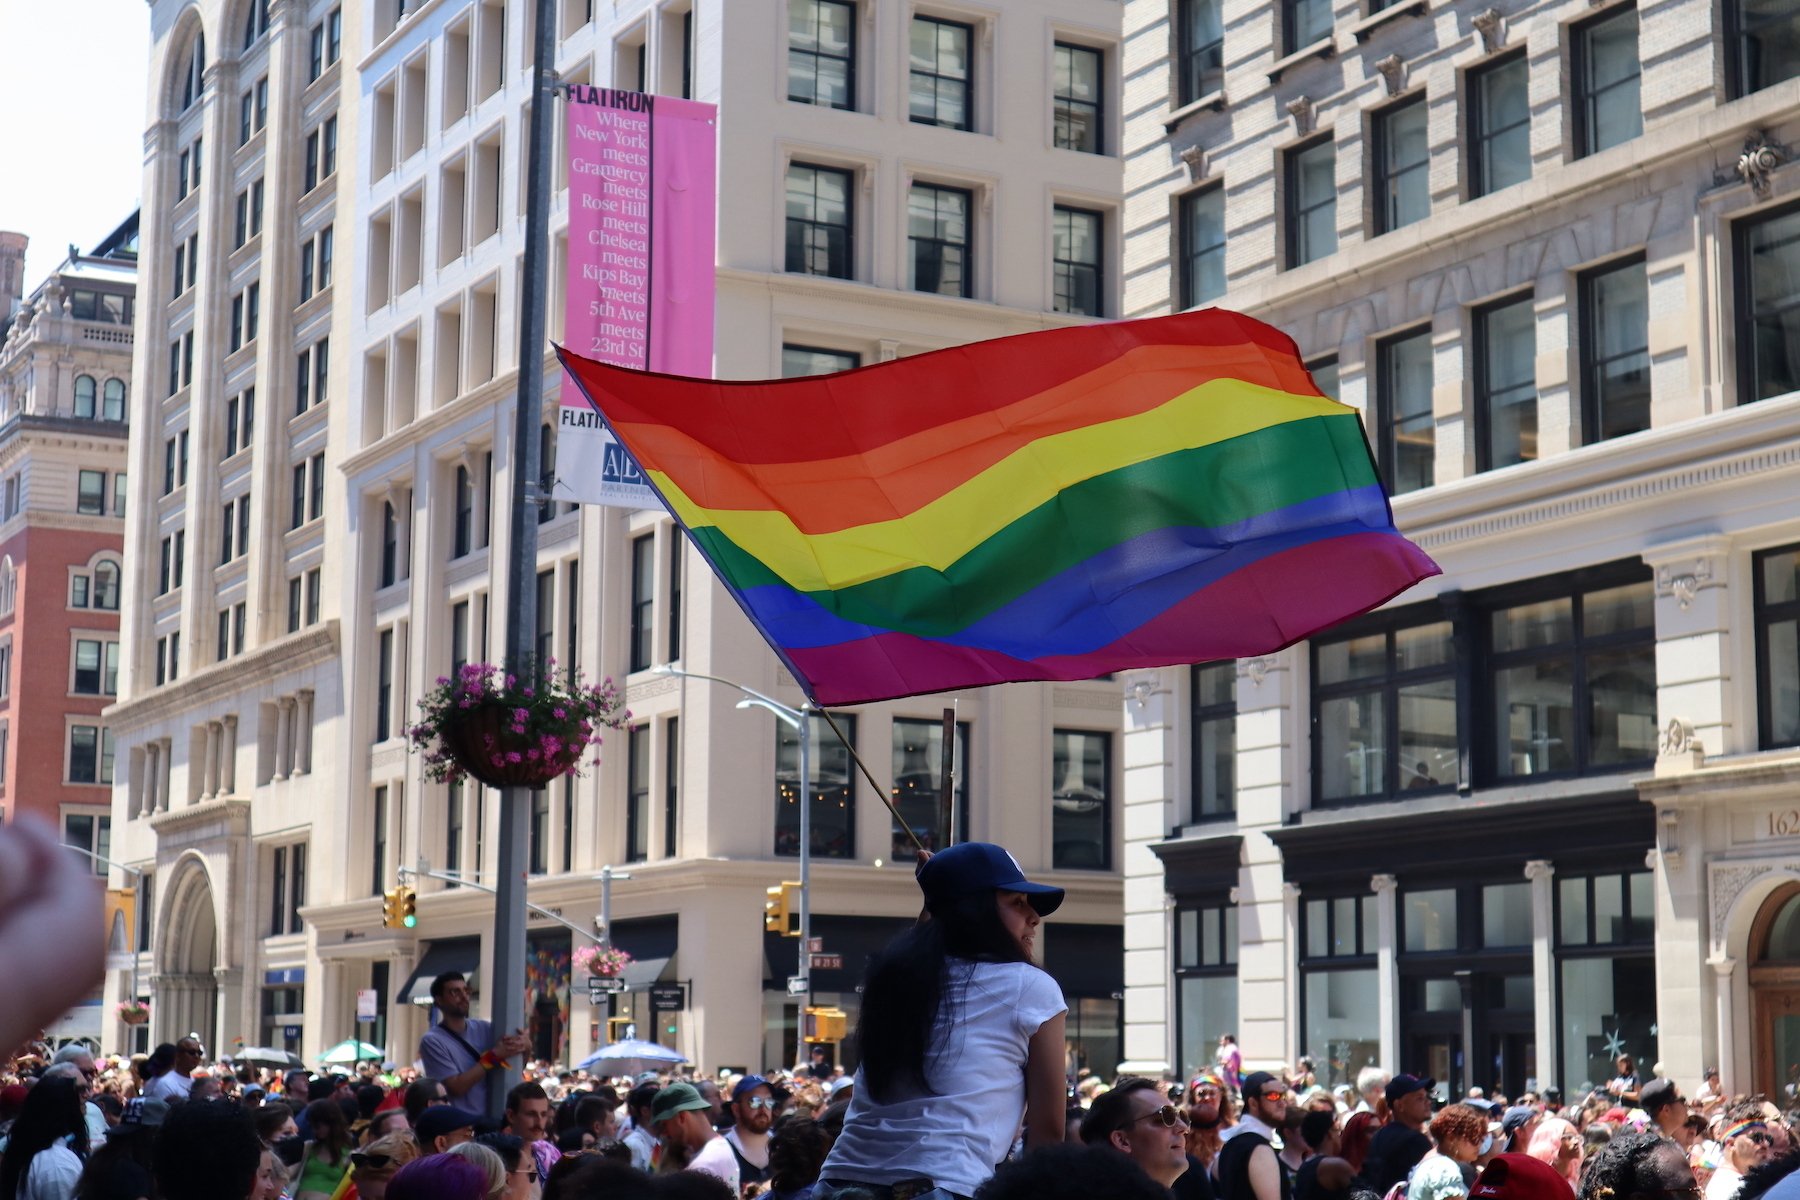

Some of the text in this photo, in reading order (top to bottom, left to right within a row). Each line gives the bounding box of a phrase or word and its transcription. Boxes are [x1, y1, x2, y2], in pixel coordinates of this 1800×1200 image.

[566, 84, 654, 114] FLATIRON
[597, 111, 647, 132] Where
[575, 124, 647, 149] New York
[603, 148, 647, 166] meets
[572, 157, 647, 185] Gramercy
[603, 181, 647, 199] meets
[582, 193, 646, 217] Rose Hill
[603, 216, 646, 234] meets
[588, 229, 646, 252] Chelsea
[602, 251, 646, 269] meets
[583, 263, 646, 289] Kips Bay
[601, 286, 645, 304] meets
[589, 300, 645, 322] 5th Ave
[600, 322, 644, 340] meets
[590, 336, 644, 357] 23rd St
[562, 409, 608, 430] FLATI
[1768, 810, 1800, 836] 162
